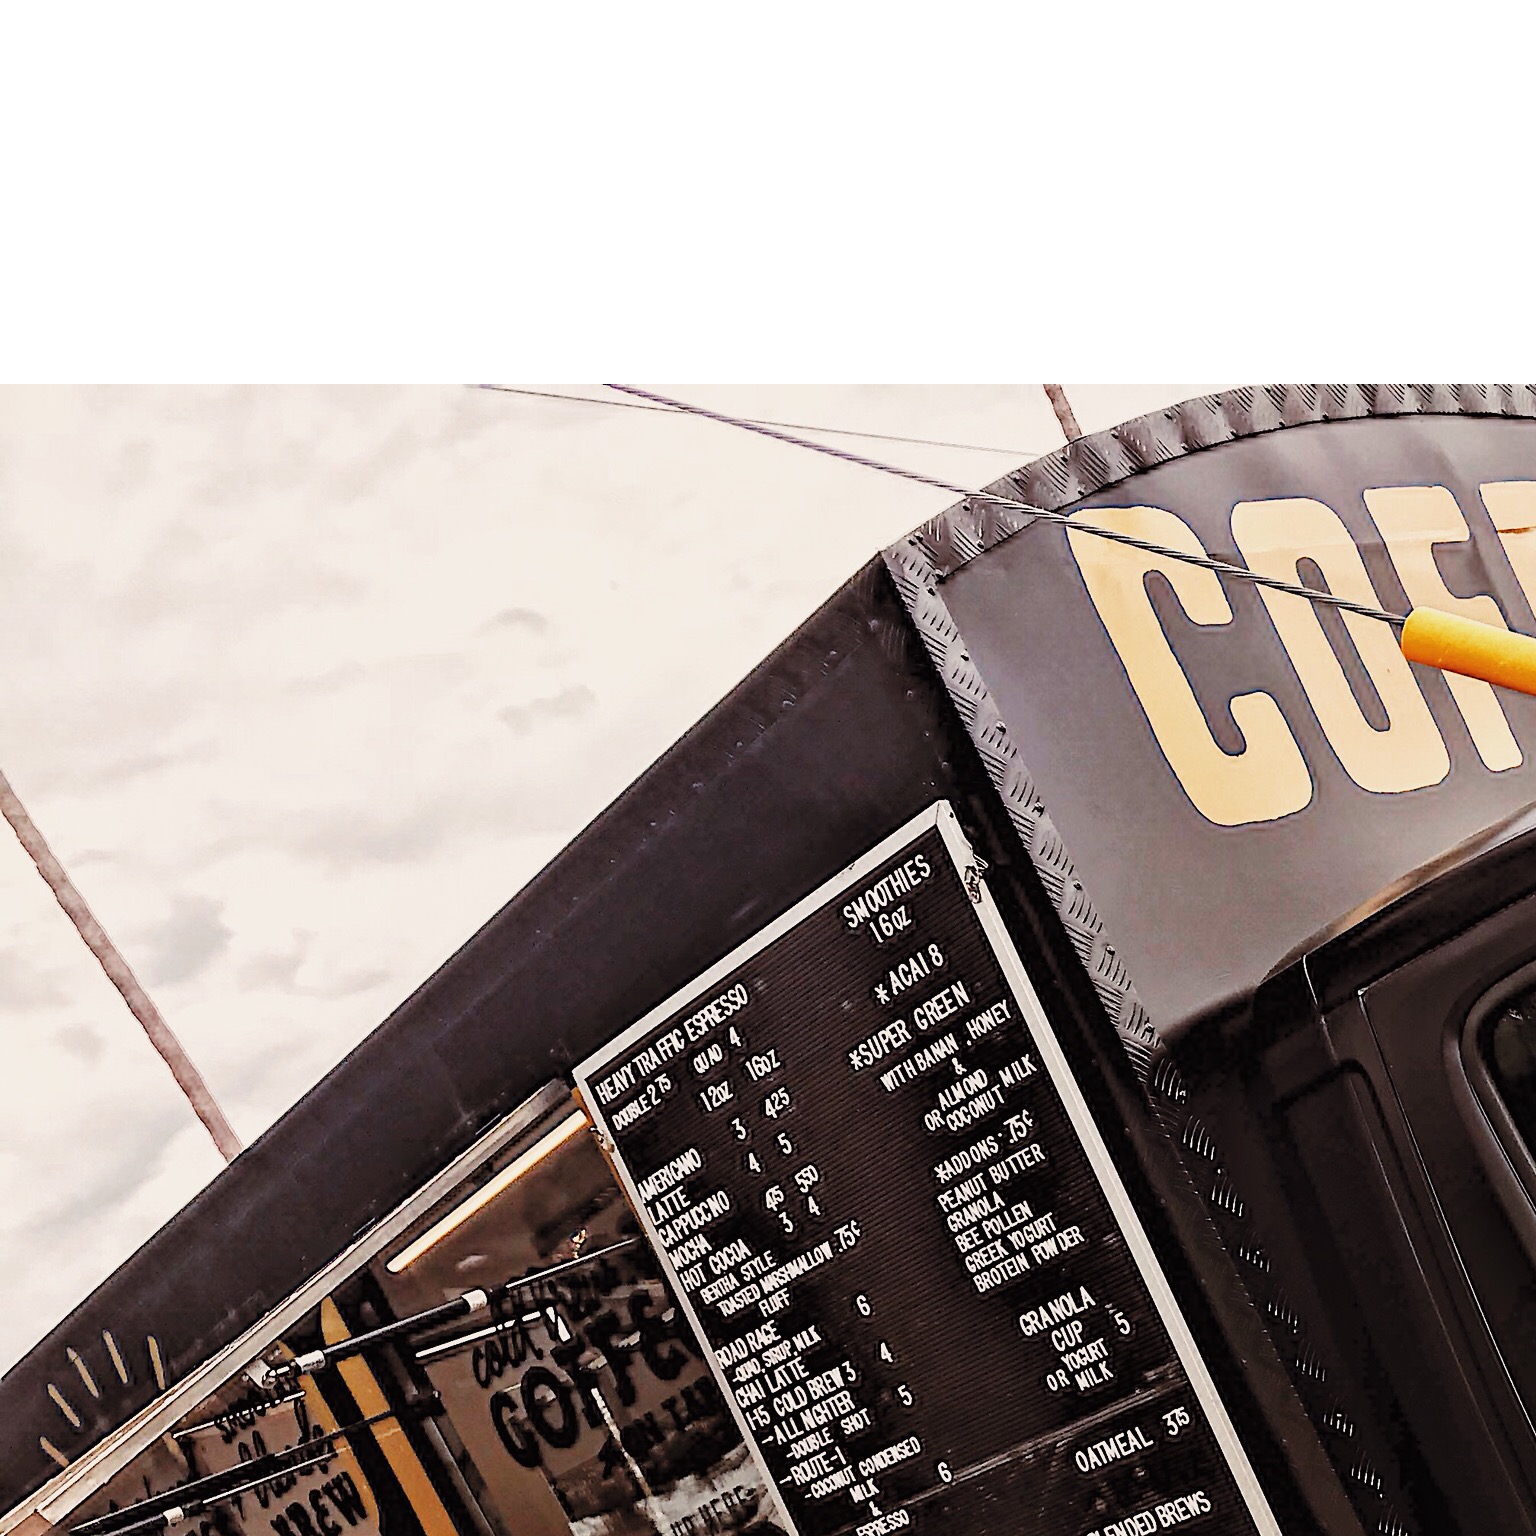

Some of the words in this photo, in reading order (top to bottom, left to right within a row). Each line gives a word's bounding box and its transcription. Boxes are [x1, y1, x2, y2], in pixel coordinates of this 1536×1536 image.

[843, 854, 931, 928] SMOOTHIES
[928, 944, 943, 967] 8
[914, 980, 971, 1030] GREEN
[595, 1061, 635, 1105] HEAVY
[632, 1029, 685, 1077] TRAFFIC
[683, 983, 748, 1042] ESPRESSO
[951, 1057, 967, 1075] &
[612, 1095, 652, 1131] DOUBLE
[692, 1043, 724, 1074] QUAD
[728, 1026, 742, 1047] 4
[880, 1051, 918, 1092] WITH
[923, 1109, 945, 1131] OR
[938, 1068, 988, 1112] ALMOND
[999, 1054, 1038, 1088] MILK
[946, 1084, 1005, 1132] COCONUT
[637, 1147, 702, 1203] AMERICANO
[731, 1117, 747, 1140] 3
[646, 1186, 691, 1226] LATTE
[748, 1152, 762, 1173] 4
[777, 1132, 793, 1155] 5
[937, 1172, 987, 1213] PEANUT
[988, 1143, 1046, 1184] BUTTER
[946, 1191, 1005, 1233] GRANOLA
[955, 1226, 984, 1253] BEE
[982, 1200, 1034, 1239] POLLEN
[667, 1233, 713, 1271] MOCHA
[680, 1262, 707, 1292] HOT
[708, 1238, 752, 1275] COCOA
[778, 1212, 793, 1233] 3
[808, 1196, 821, 1216] 4
[965, 1239, 1009, 1274] GREEK
[1007, 1212, 1057, 1251] YOGURT
[973, 1252, 1030, 1293] BROTEIN
[1030, 1225, 1085, 1265] POWDER
[700, 1273, 741, 1305] BERTHA
[740, 1250, 777, 1282] STYLE
[716, 1282, 761, 1317] TOASTED
[760, 1241, 834, 1294] MARSHMALLOW
[758, 1288, 792, 1317] FLUFF
[856, 1295, 871, 1316] 6
[1019, 1286, 1096, 1337] GRANOLA
[714, 1340, 748, 1369] ROAD
[746, 1320, 782, 1351] RAGE
[1051, 1320, 1084, 1352] CUP
[1114, 1312, 1130, 1335] 5
[1060, 1338, 1109, 1374] YOGURT
[735, 1374, 766, 1409] CHAI
[764, 1357, 810, 1393] LATTE
[774, 1385, 806, 1416] COLD
[809, 1369, 846, 1400] BREW
[842, 1360, 857, 1382] 3
[879, 1342, 893, 1363] 4
[1046, 1371, 1070, 1392] OR
[1075, 1361, 1114, 1391] MILK
[840, 1408, 872, 1435] SHOT
[897, 1385, 913, 1405] 5
[858, 1436, 921, 1477] CONDENSED
[1075, 1426, 1154, 1473] OATMEAL
[849, 1478, 880, 1503] MILK
[869, 1500, 882, 1516] &
[937, 1462, 952, 1483] 6
[1155, 1491, 1211, 1528] BREWS
